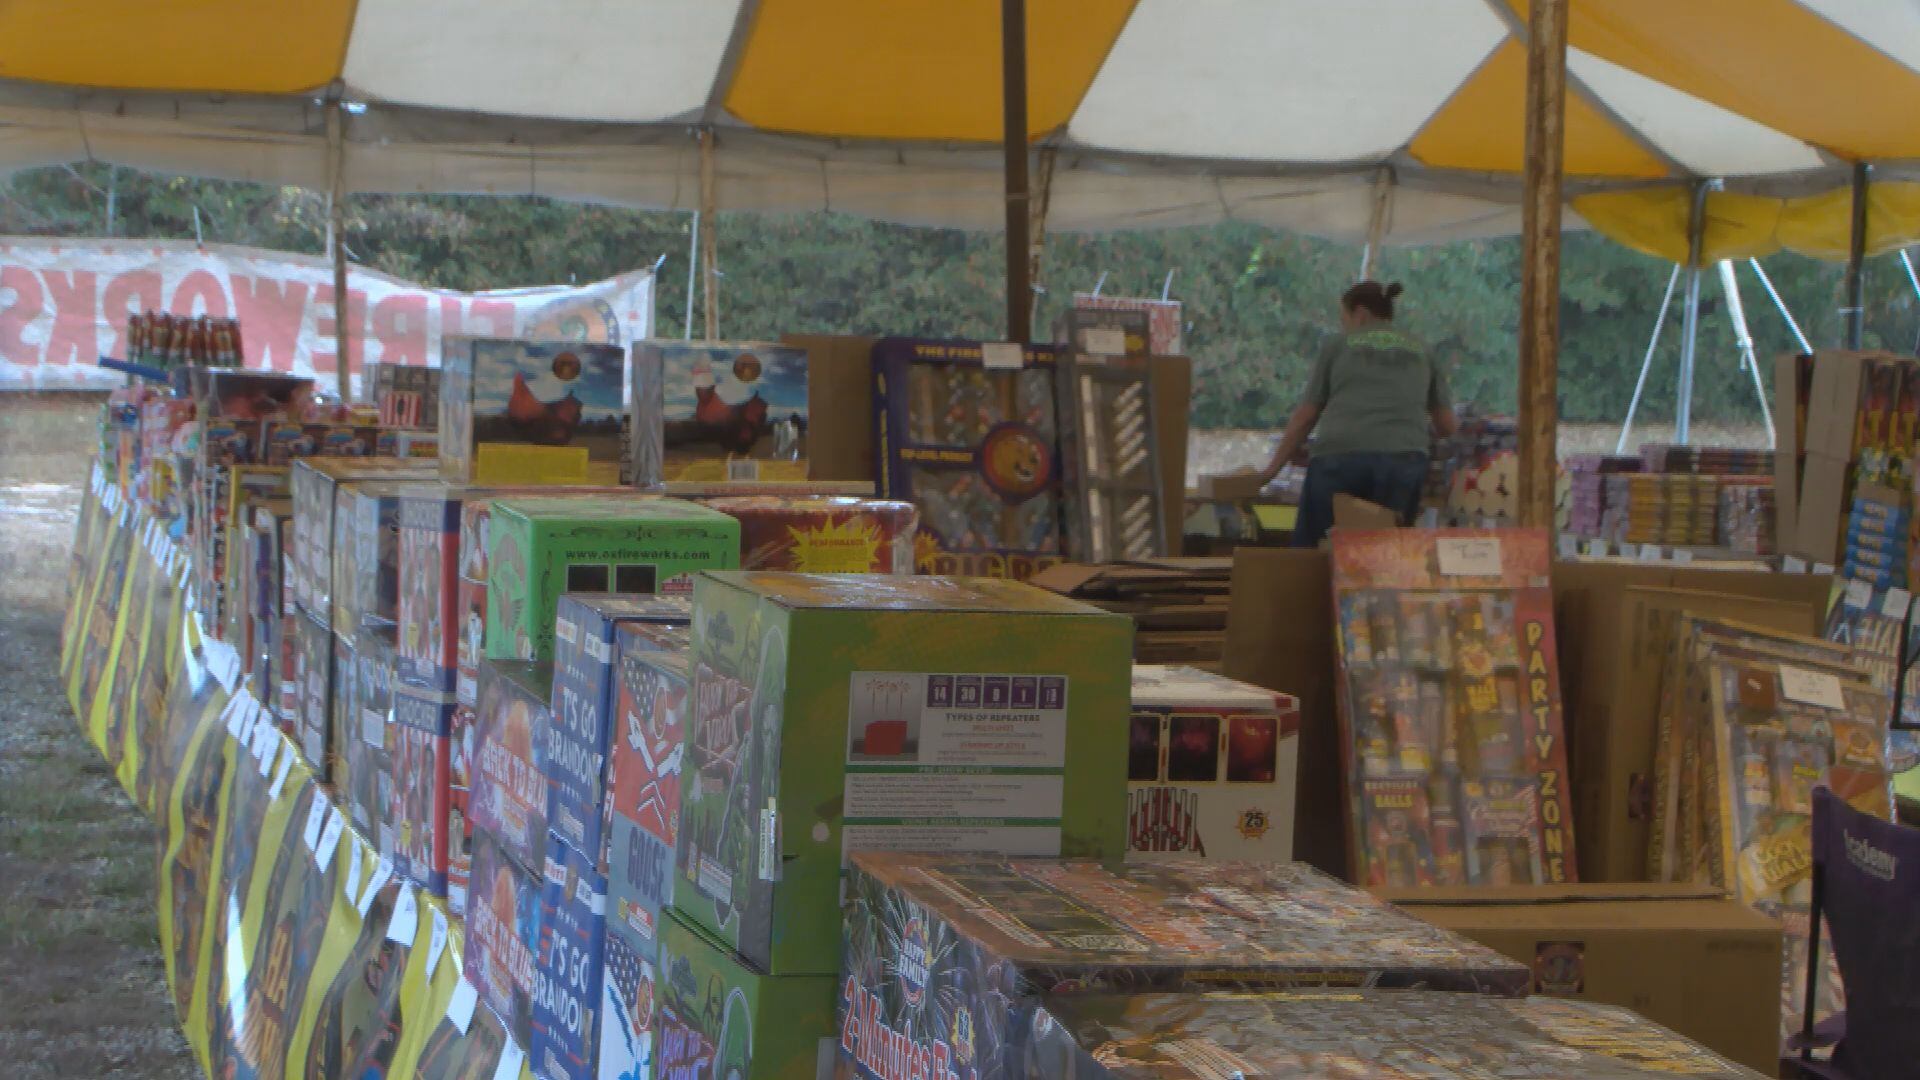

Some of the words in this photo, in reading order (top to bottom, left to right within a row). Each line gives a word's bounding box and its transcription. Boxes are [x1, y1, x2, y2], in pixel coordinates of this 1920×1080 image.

[1526, 621, 1554, 760] PARTY
[581, 699, 597, 743] GO
[945, 713, 973, 722] TYPES
[990, 714, 1040, 722] REPEATERS
[1246, 812, 1264, 828] 25
[1539, 770, 1565, 883] ZONE
[570, 946, 590, 994] GO
